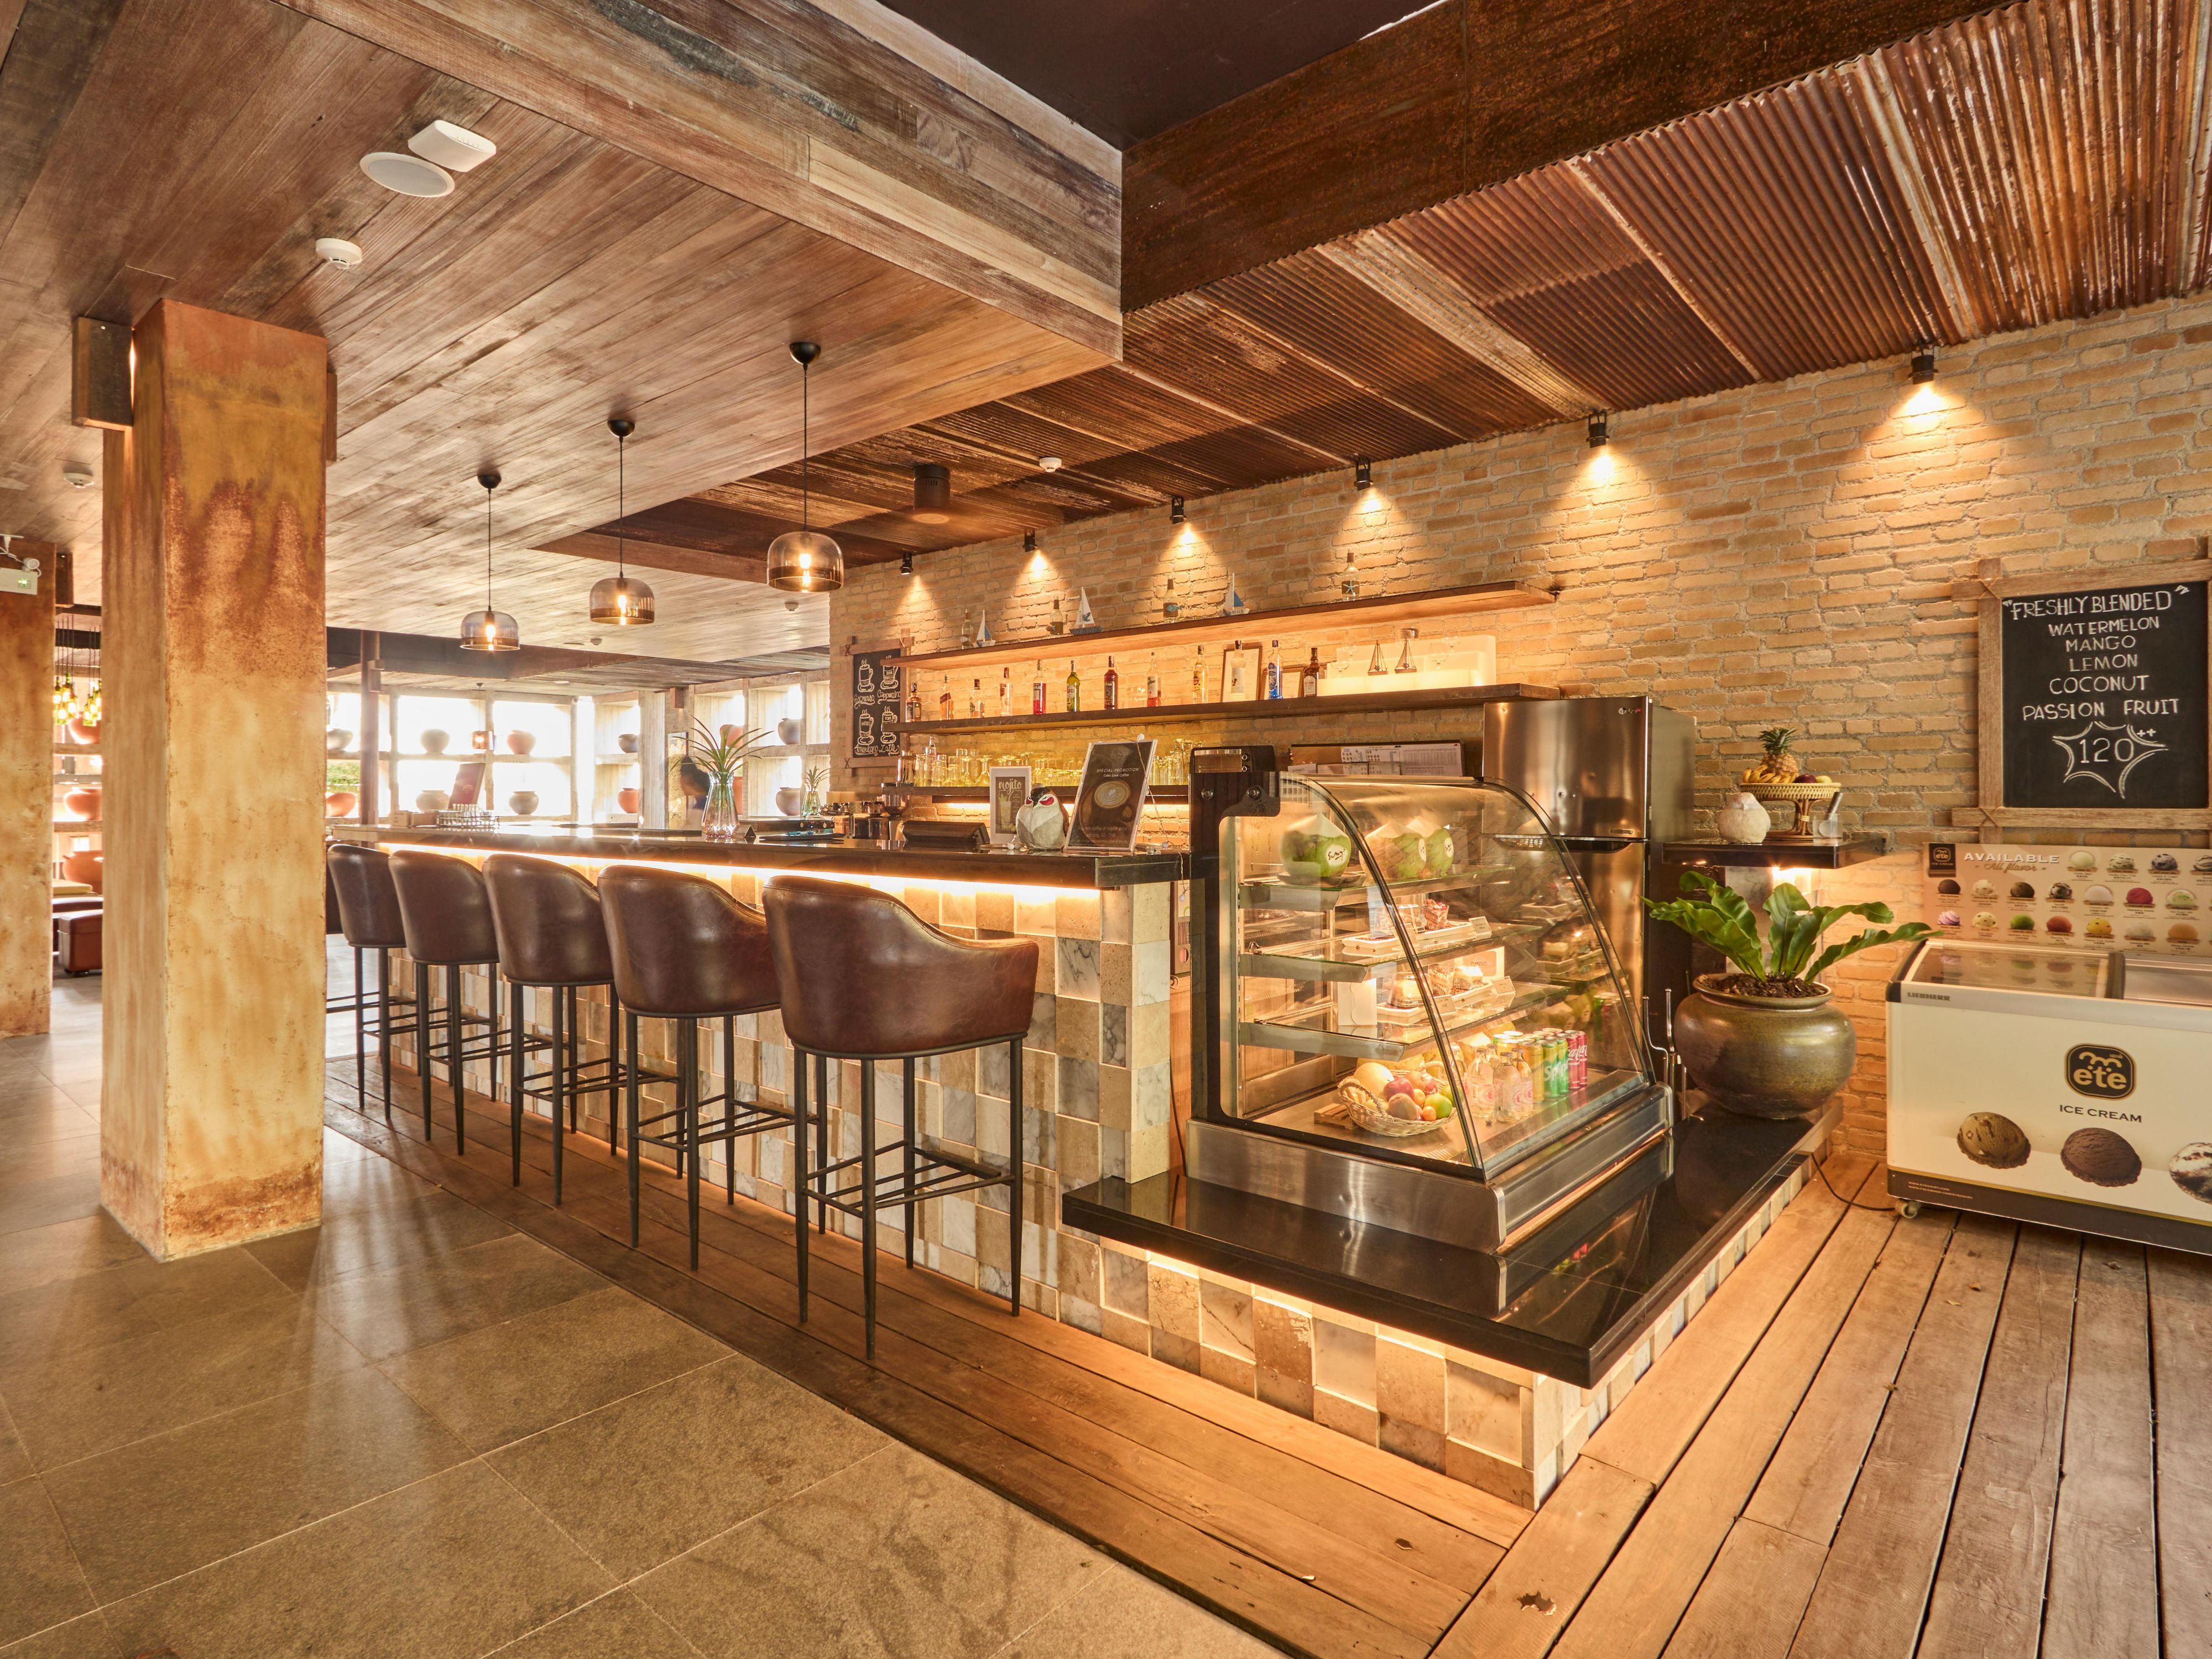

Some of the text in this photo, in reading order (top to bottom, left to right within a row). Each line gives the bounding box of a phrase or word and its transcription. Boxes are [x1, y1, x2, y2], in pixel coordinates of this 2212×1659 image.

[2048, 615, 2159, 637] WATERMELON
[2065, 635, 2136, 653] MANGO
[2069, 654, 2138, 672] LEMON
[2049, 675, 2150, 694] COCONUT
[2022, 698, 2180, 721] PASSION FRUIT
[2079, 738, 2135, 764] 120
[1964, 853, 2060, 864] AVAILABLE
[1984, 862, 2037, 874] All flavor
[1907, 992, 1951, 1001] LIEBHERR
[2059, 1105, 2142, 1123] ICE CREAM
